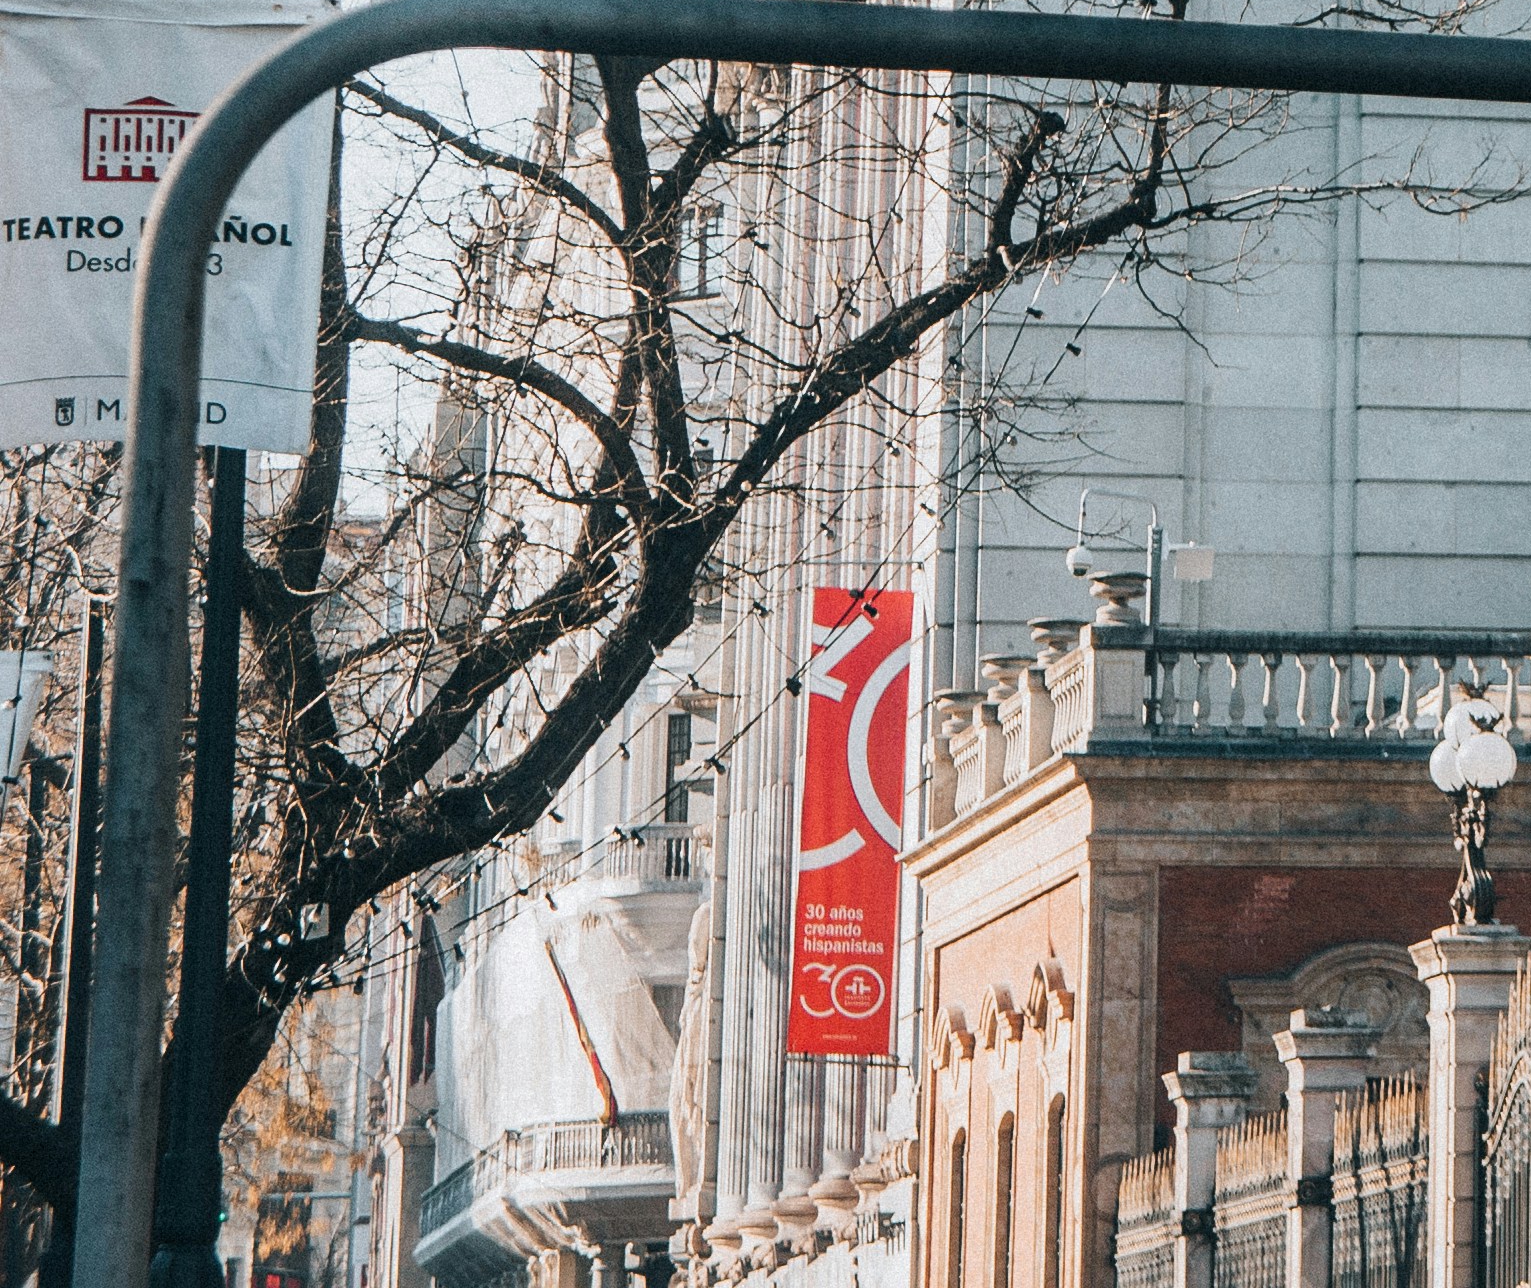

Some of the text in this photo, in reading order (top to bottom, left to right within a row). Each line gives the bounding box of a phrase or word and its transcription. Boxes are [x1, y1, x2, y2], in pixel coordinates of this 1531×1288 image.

[3, 215, 125, 242] TEATRO
[804, 903, 864, 921] 30 años
[804, 922, 862, 937] creando
[803, 935, 884, 956] hispanistas
